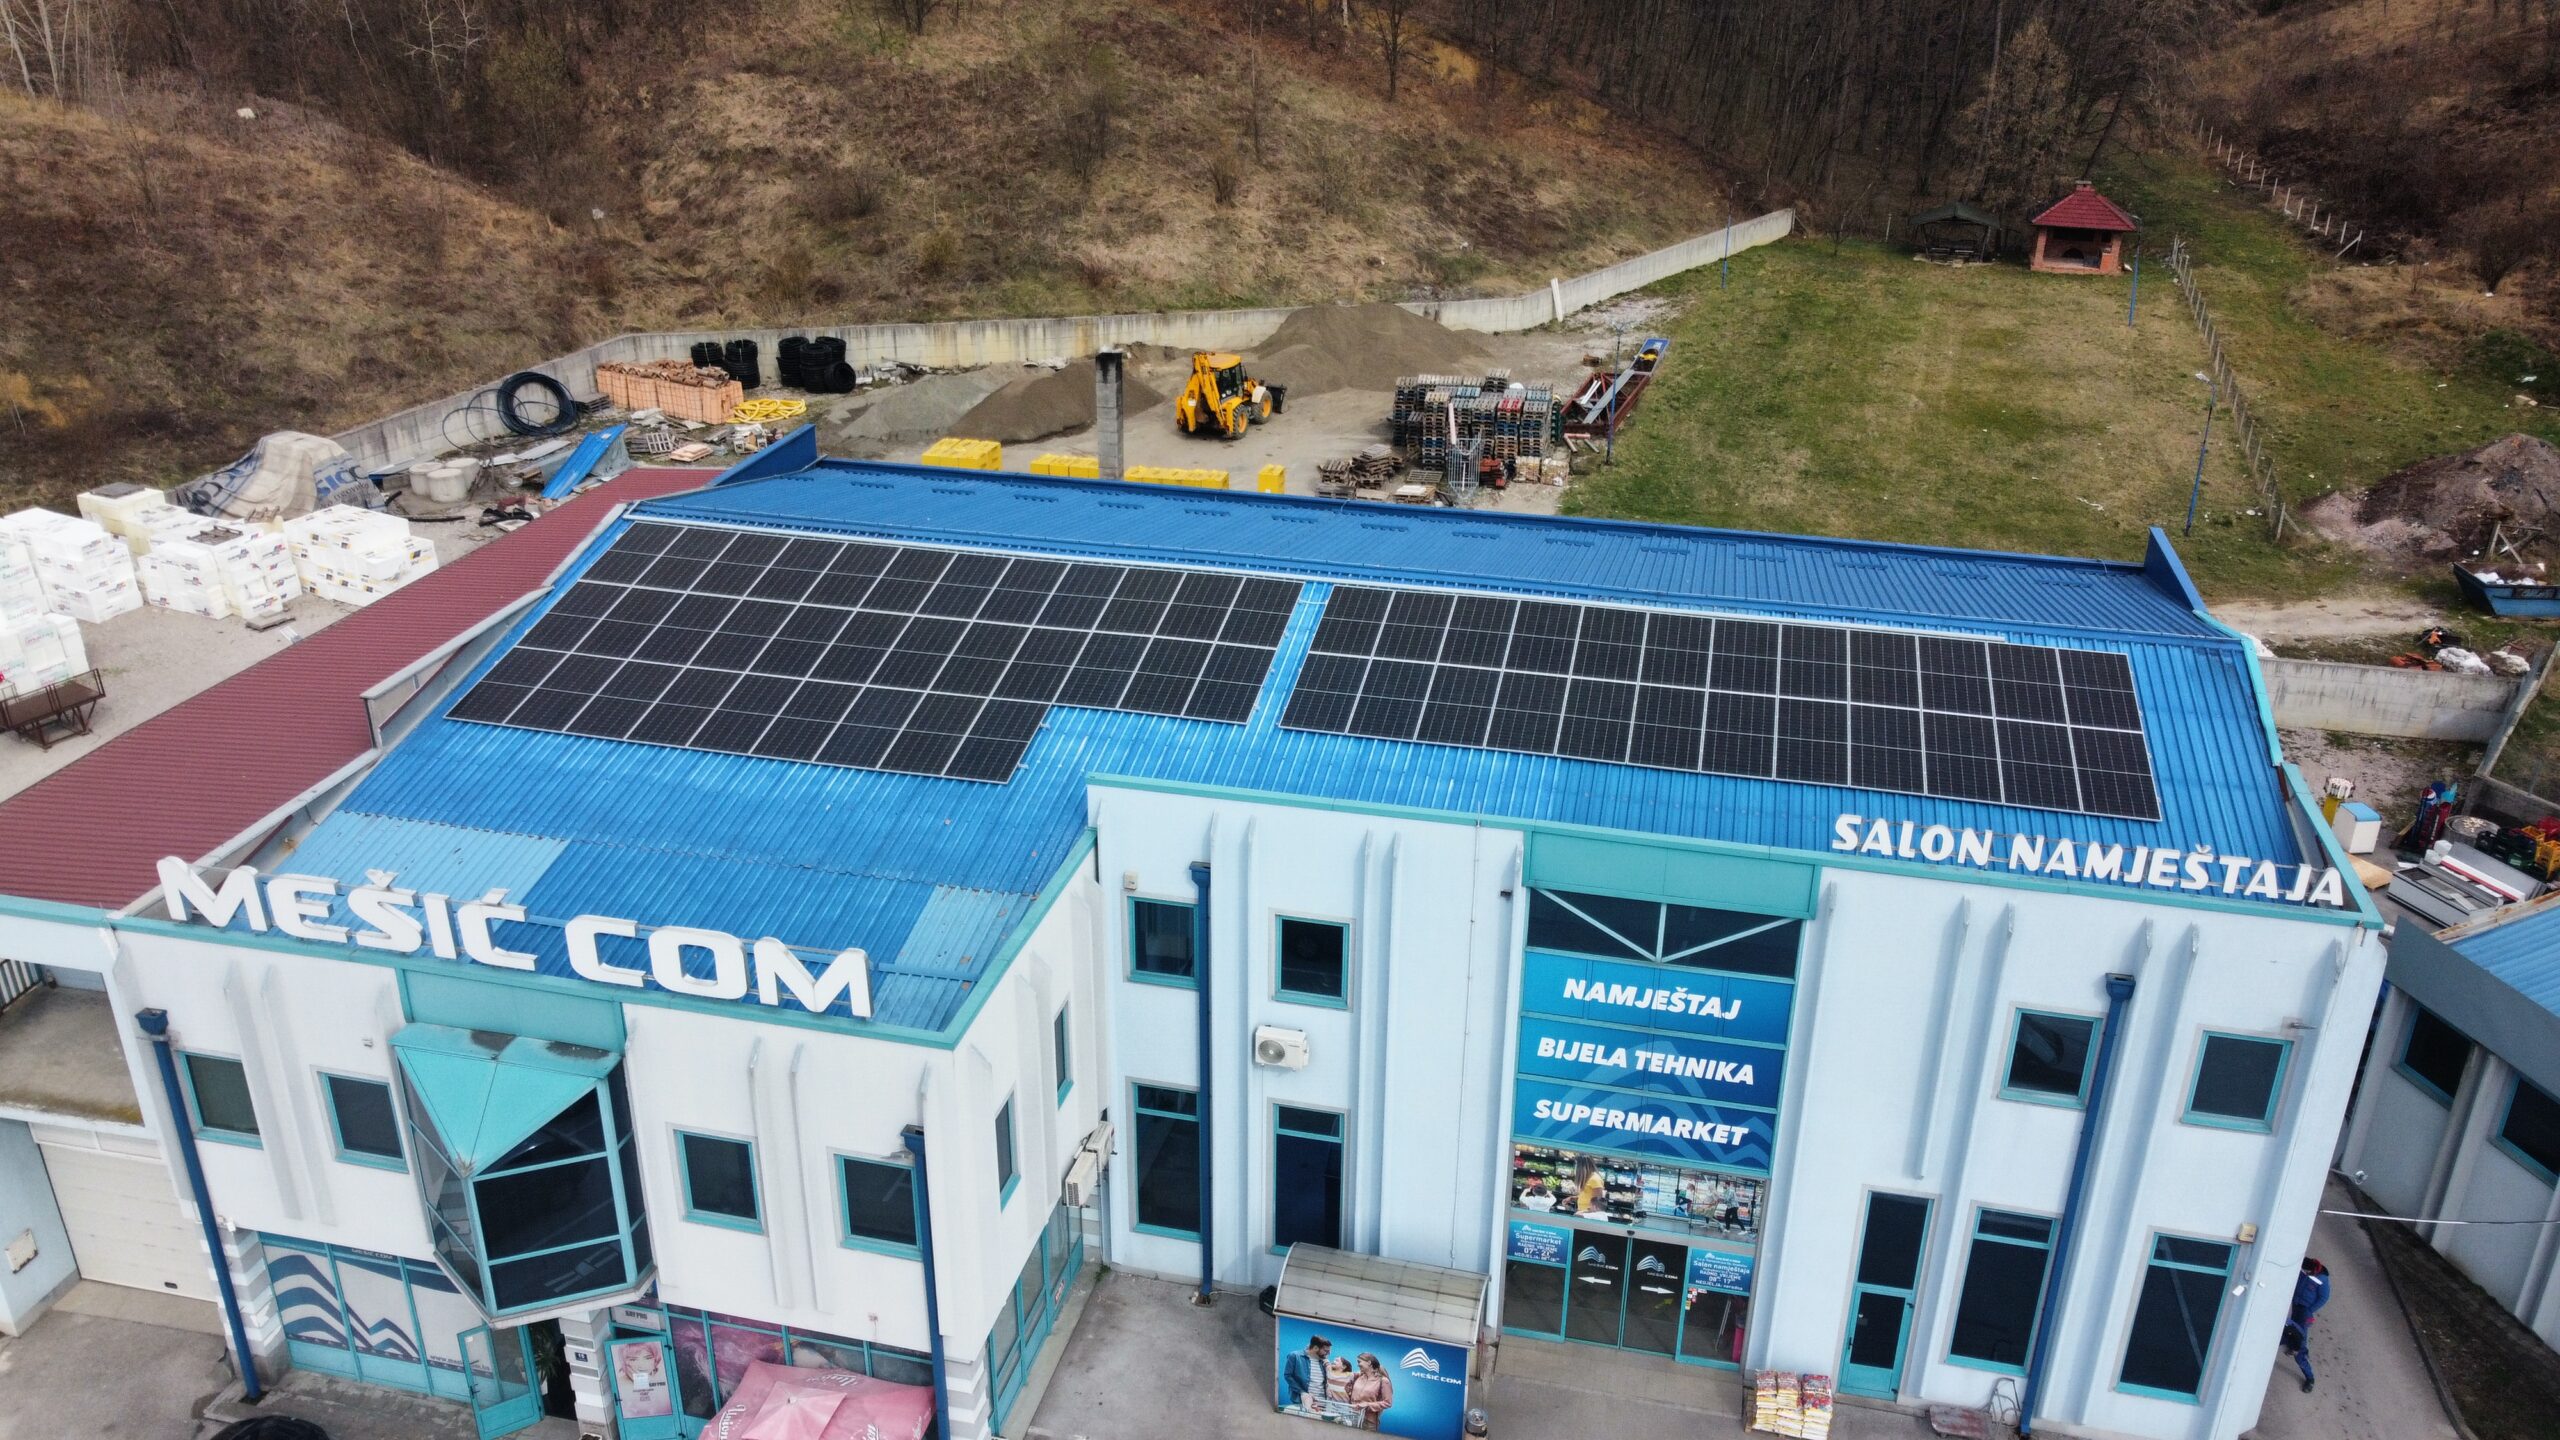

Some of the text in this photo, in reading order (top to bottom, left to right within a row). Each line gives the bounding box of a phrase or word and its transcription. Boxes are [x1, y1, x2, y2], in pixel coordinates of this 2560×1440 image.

[1832, 813, 2346, 907] SALON NAMJEŠTAJA
[157, 855, 873, 1018] MEŠIĆ COM
[1563, 978, 1742, 1021] NAMJEŠTAJ
[1537, 1037, 1755, 1086] BIJELA TEHNIKA
[1533, 1099, 1750, 1147] SUPERMARKET
[1515, 1232, 1562, 1246] Supermarket
[1411, 1371, 1462, 1385] MEŠIĆ COM
